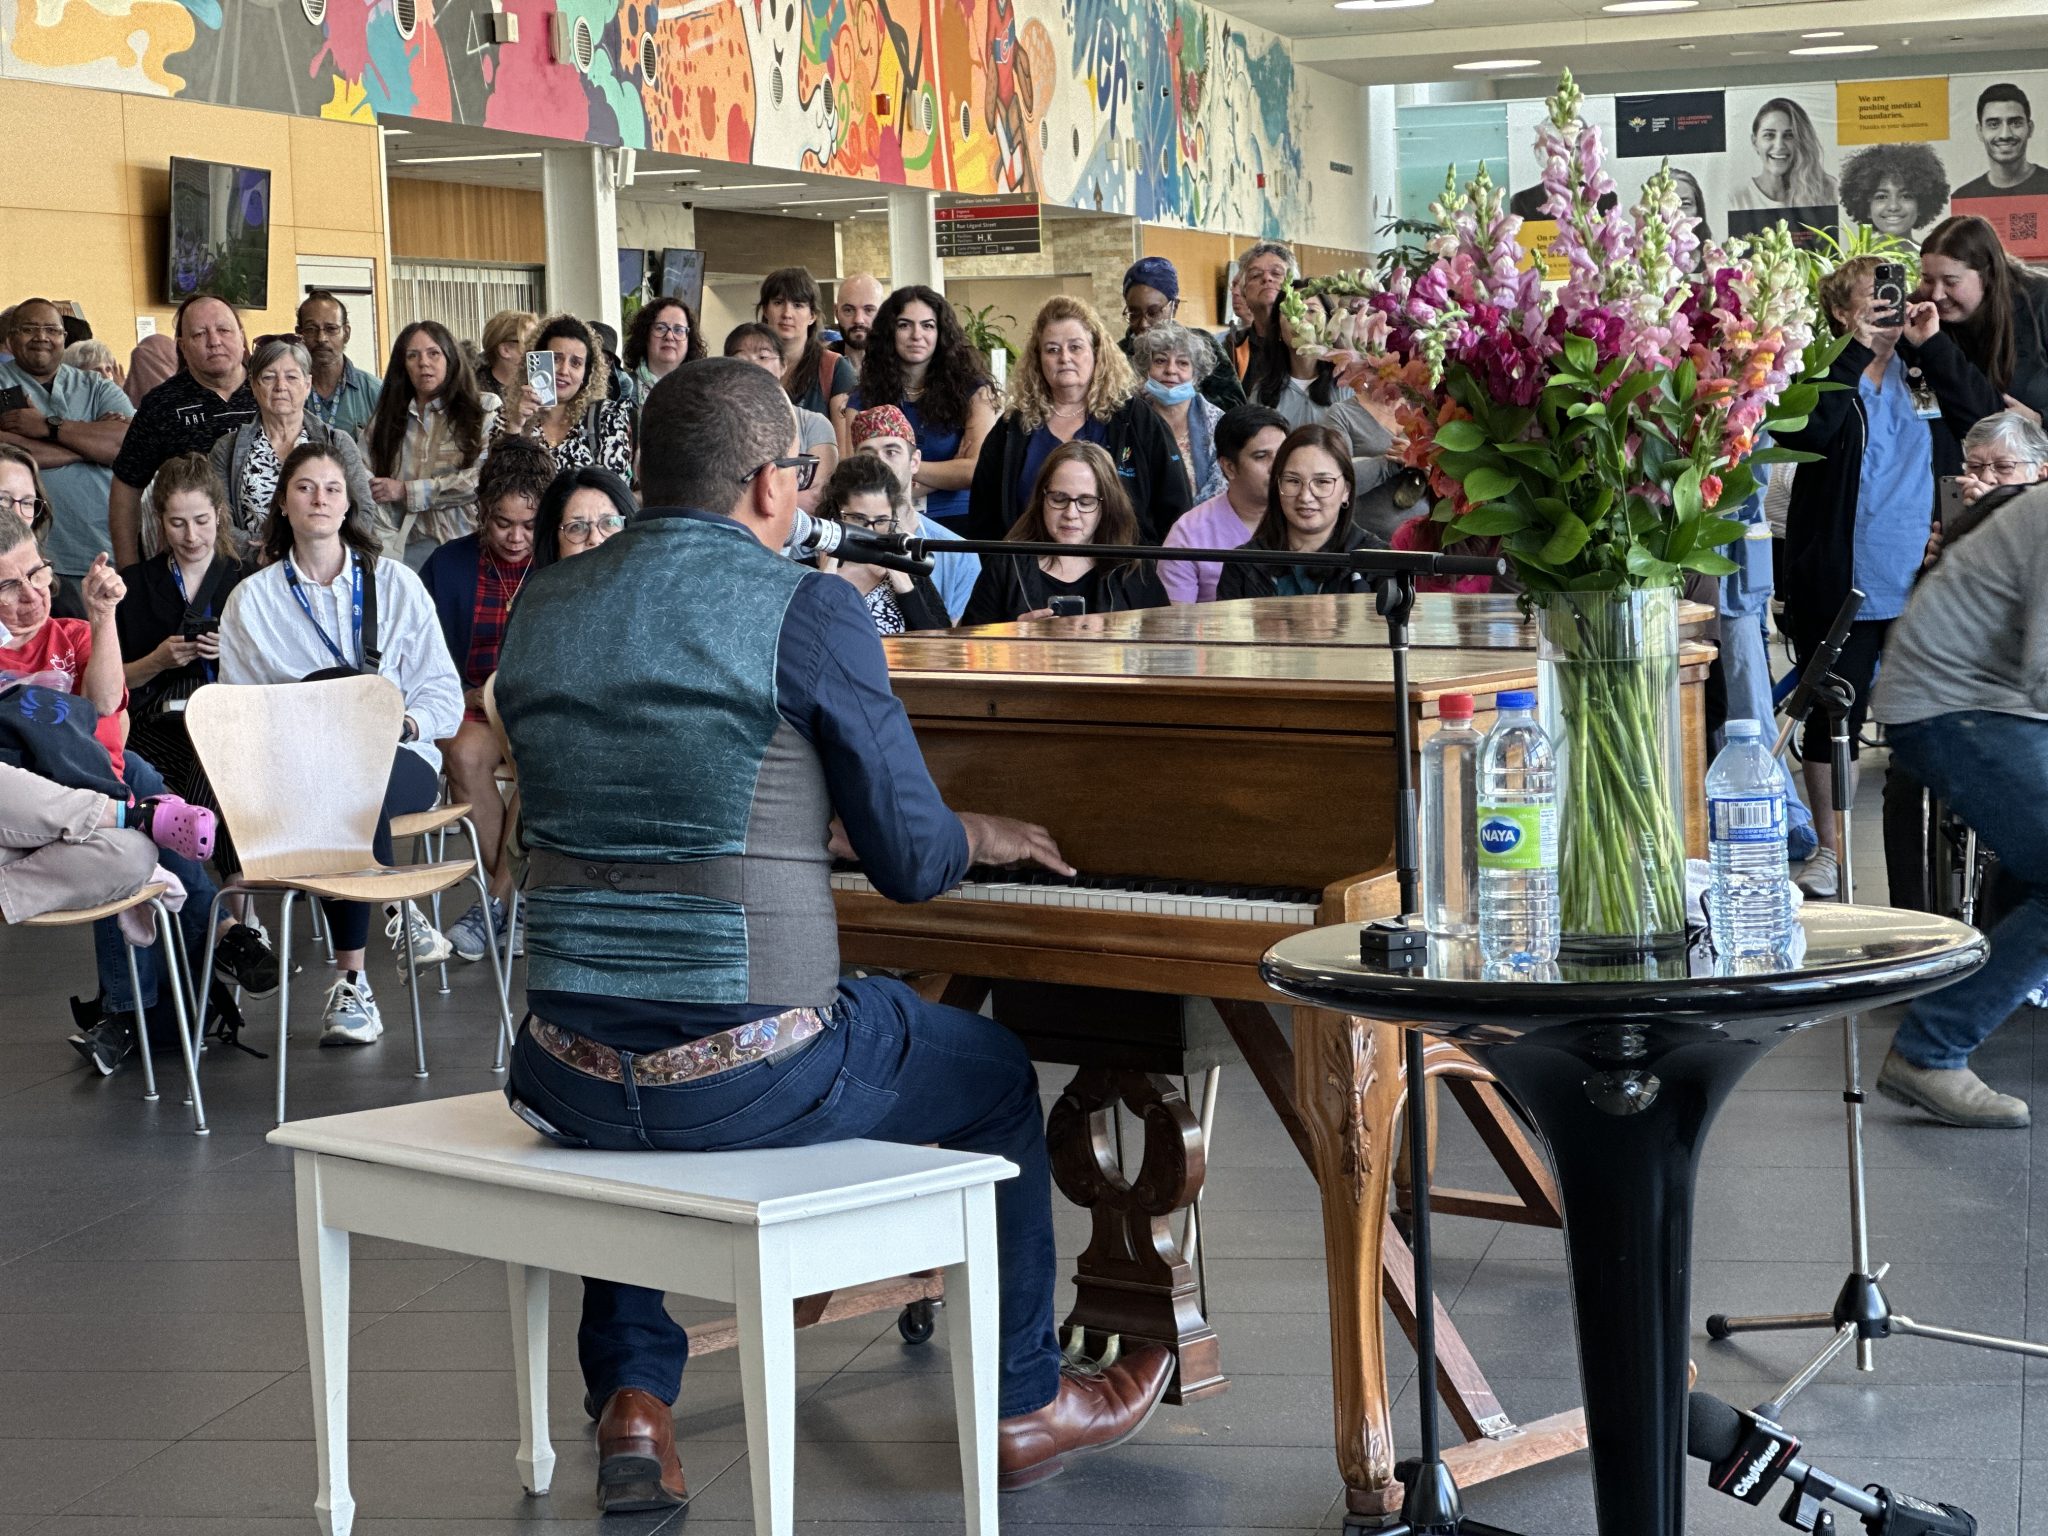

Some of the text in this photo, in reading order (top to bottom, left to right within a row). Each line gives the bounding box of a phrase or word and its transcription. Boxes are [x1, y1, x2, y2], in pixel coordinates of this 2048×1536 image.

[1858, 95, 1871, 103] We
[1858, 101, 1922, 112] pushing medical
[1858, 111, 1904, 120] boundaries.
[185, 412, 206, 426] ART
[1481, 829, 1516, 842] NAYA
[1733, 1439, 1780, 1497] CityNews
